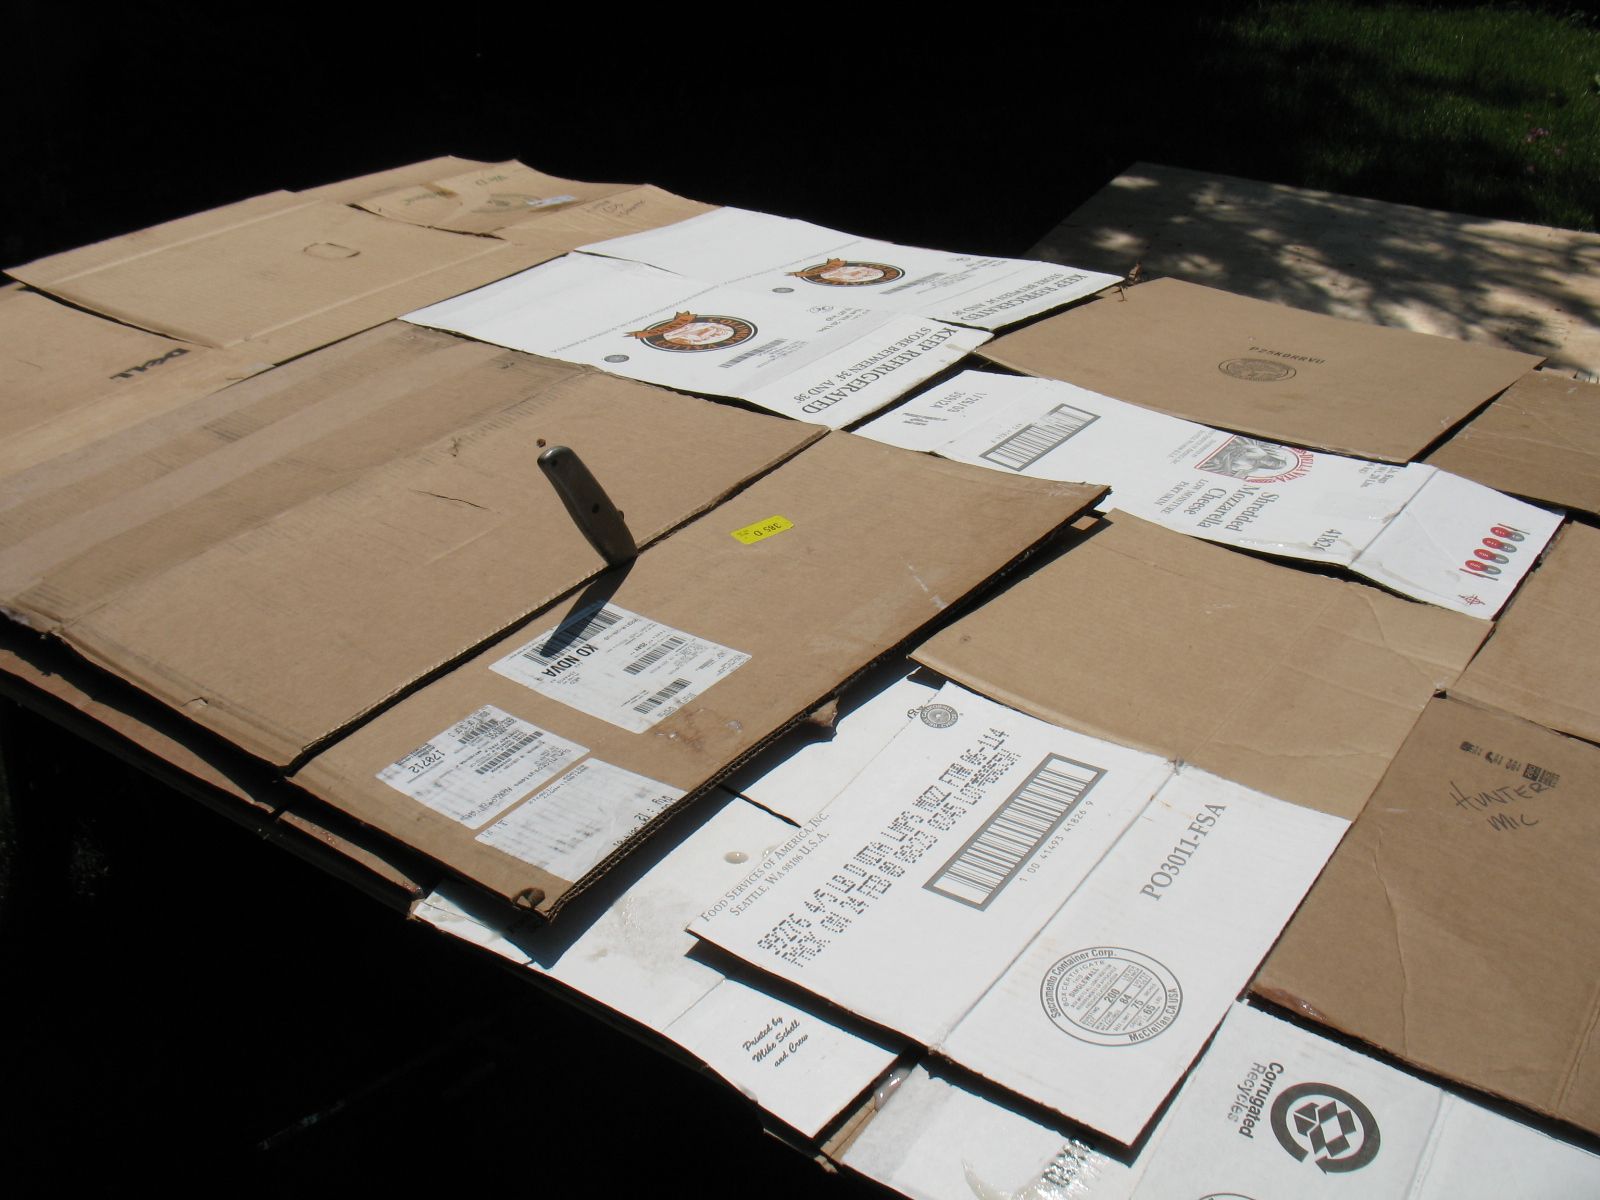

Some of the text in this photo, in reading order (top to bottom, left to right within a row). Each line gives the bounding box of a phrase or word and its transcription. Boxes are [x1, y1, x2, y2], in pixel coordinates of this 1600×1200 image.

[1058, 274, 1088, 287] KEEP
[893, 327, 932, 348] STORE
[918, 327, 958, 354] KEEP
[850, 345, 902, 373] BETWEEN
[802, 349, 921, 415] REFRIGERATED
[811, 379, 838, 395] AND
[1184, 488, 1227, 516] Cheese
[1197, 484, 1260, 528] Mozzarella
[1226, 491, 1280, 533] Shredded
[540, 643, 600, 677] KD NDVA
[1449, 781, 1550, 811] HUNTER
[1026, 861, 1042, 873] 00
[1041, 835, 1065, 859] 41493
[1064, 808, 1089, 833] 41826
[1139, 802, 1228, 900] PO3011-FSA
[700, 900, 729, 922] FOOD
[725, 868, 764, 900] SERVICES
[777, 827, 815, 859] AMERICA,
[811, 812, 830, 828] INC.
[730, 885, 770, 916] SEATTLE,
[783, 854, 803, 872] 98106
[803, 831, 830, 856] U.S.A.
[1052, 952, 1089, 976] Container
[1091, 949, 1117, 958] Corp.
[1046, 976, 1061, 1018] Sacramento
[1104, 988, 1120, 1003] 200
[1120, 994, 1132, 1005] 84
[1131, 998, 1144, 1010] 75
[1143, 1004, 1155, 1015] 65
[1168, 988, 1178, 1004] USA
[742, 1016, 783, 1052] Printed by
[752, 1019, 800, 1063] Mike Schell
[774, 1033, 808, 1067] and Crew
[1227, 1062, 1268, 1122] Recycles
[1238, 1062, 1284, 1138] Corrugated
